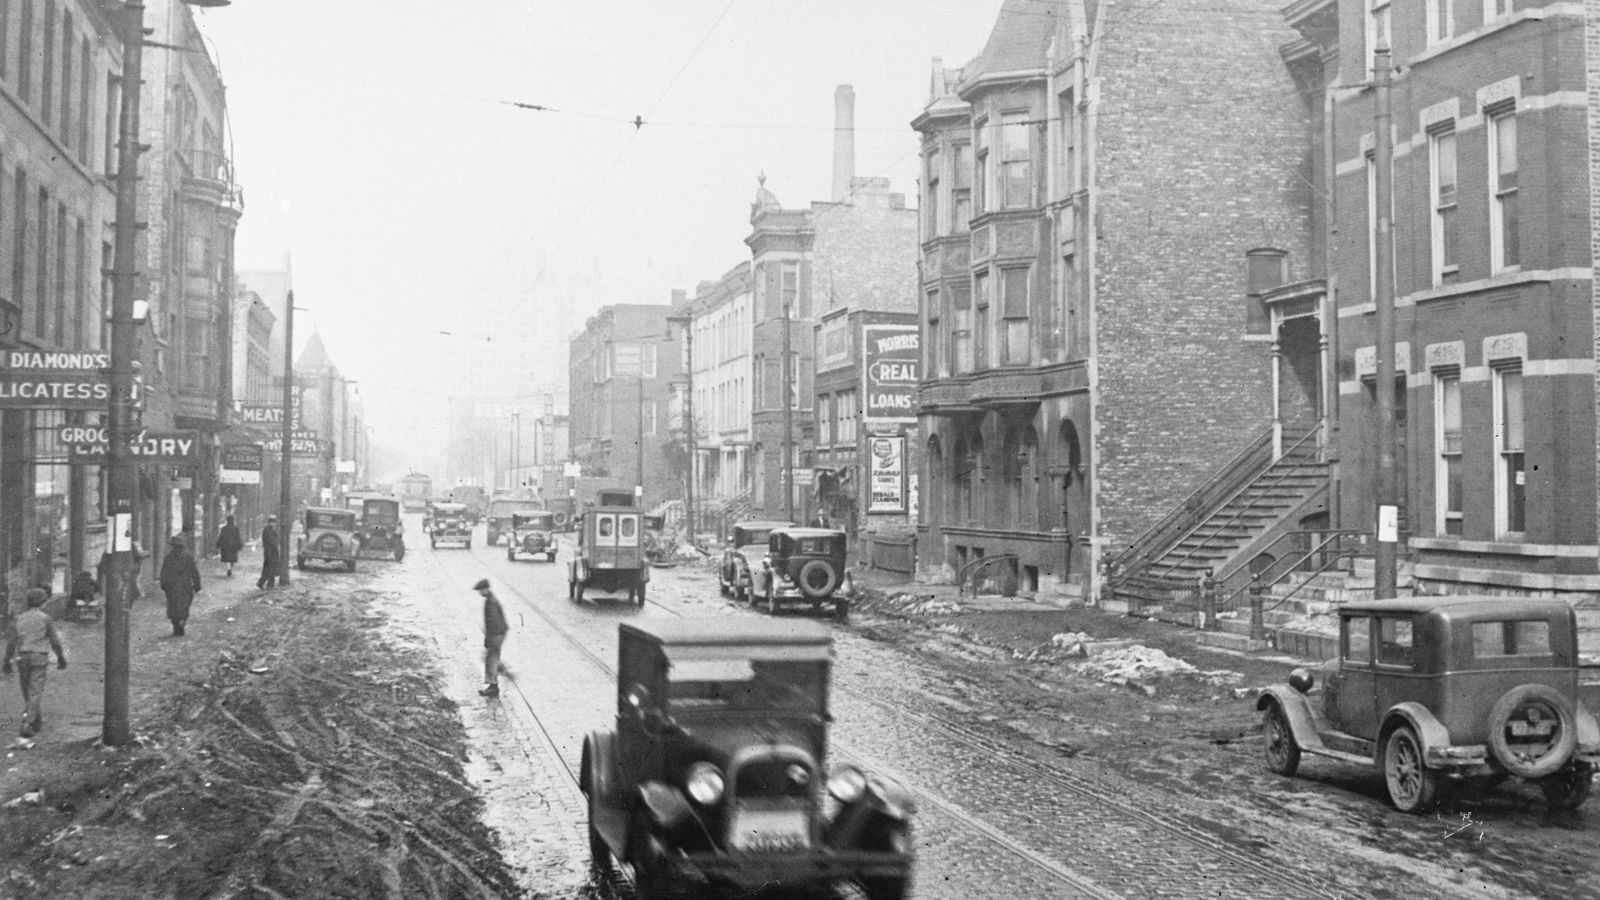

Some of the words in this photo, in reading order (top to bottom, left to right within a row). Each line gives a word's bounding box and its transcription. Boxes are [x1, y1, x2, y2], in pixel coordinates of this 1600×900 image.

[877, 334, 919, 354] MORRIS
[10, 352, 108, 369] DIAMOND'S
[880, 364, 918, 382] REAL
[290, 385, 301, 431] RUGS
